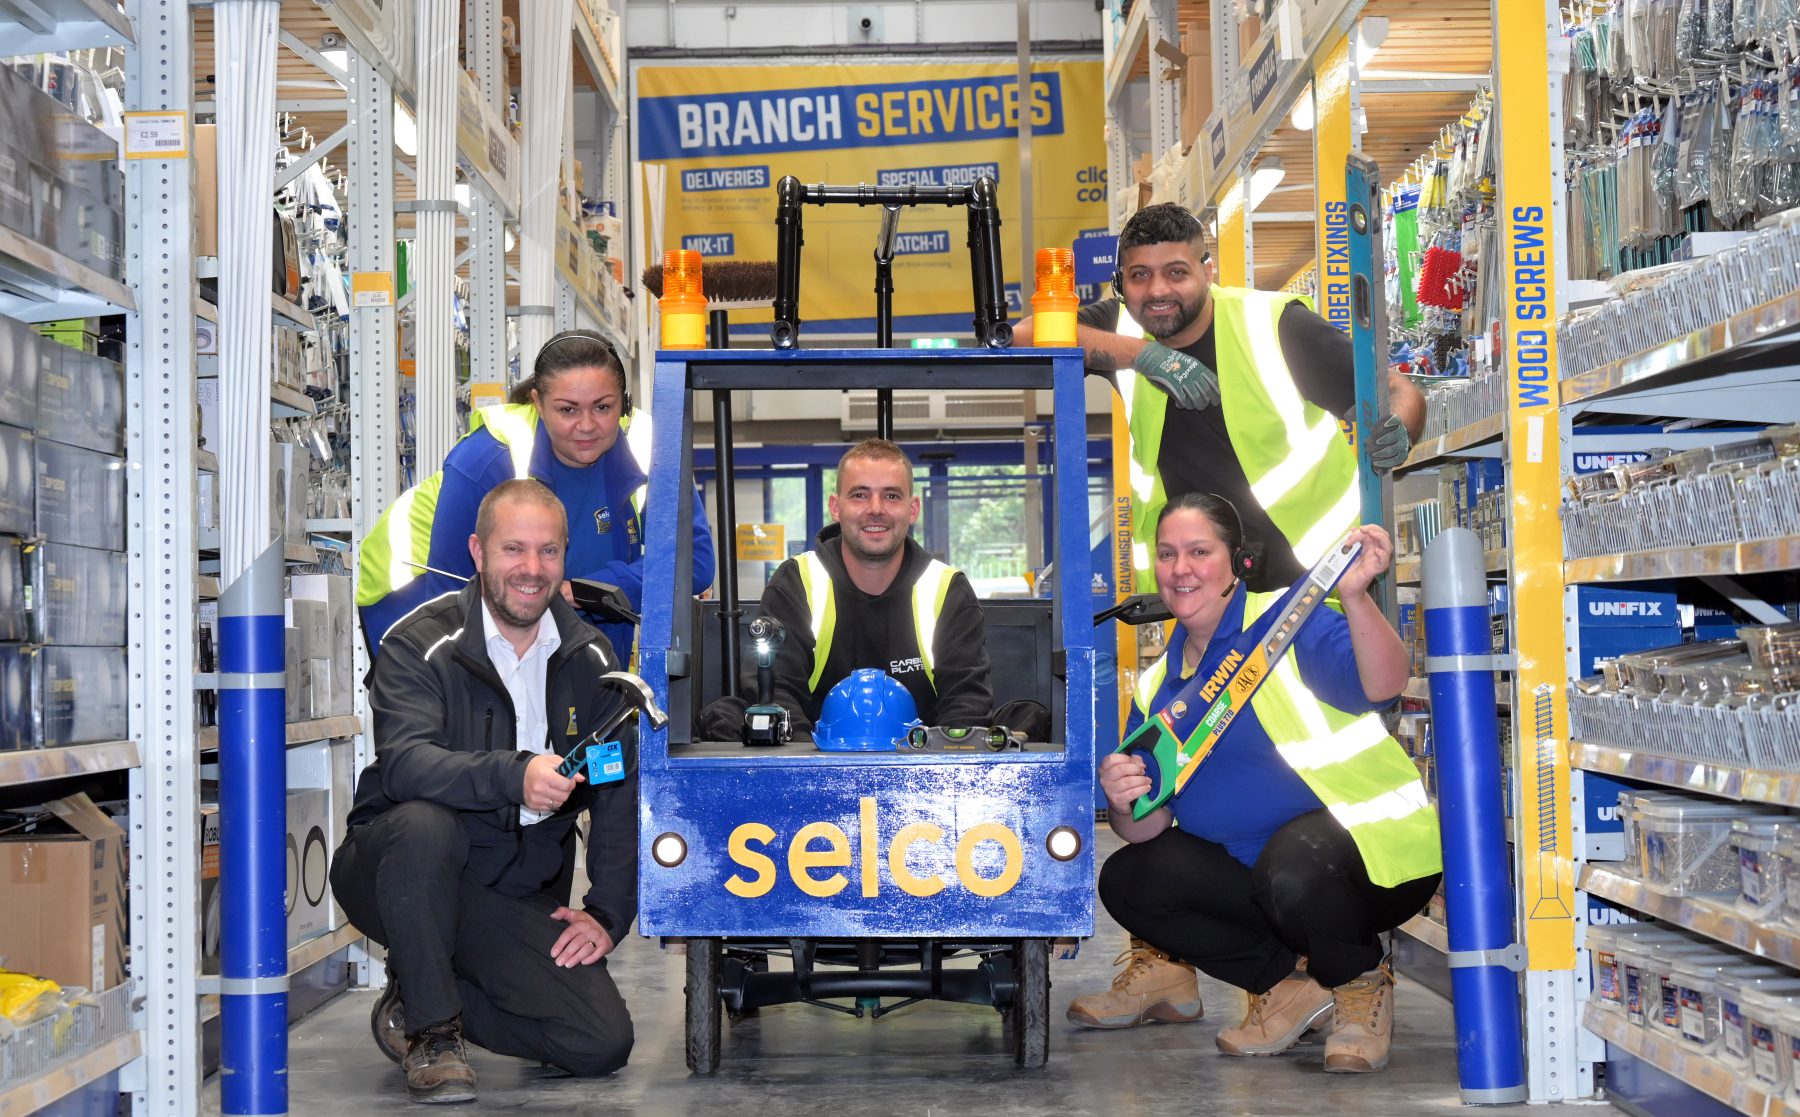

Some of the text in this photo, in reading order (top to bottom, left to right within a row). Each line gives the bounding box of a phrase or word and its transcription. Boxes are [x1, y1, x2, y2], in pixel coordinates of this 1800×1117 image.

[678, 81, 1052, 149] BRANCH SERVICES
[686, 168, 765, 190] DELIVERIES
[881, 169, 939, 187] SPECIAL
[686, 236, 729, 254] MIX-IT
[894, 233, 945, 253] ATCH-IT
[1325, 201, 1349, 276] FIXINGS
[1093, 255, 1112, 265] NAILS
[1512, 206, 1549, 409] WOOD SCREWS
[1118, 496, 1132, 593] GALVANISED NAILS
[1589, 602, 1663, 616] UNIFIX
[1199, 648, 1243, 704] IRWIN
[1237, 666, 1259, 692] JACK
[1205, 699, 1228, 728] COARSE
[1212, 718, 1227, 737] PLUS
[724, 796, 1024, 898] selco
